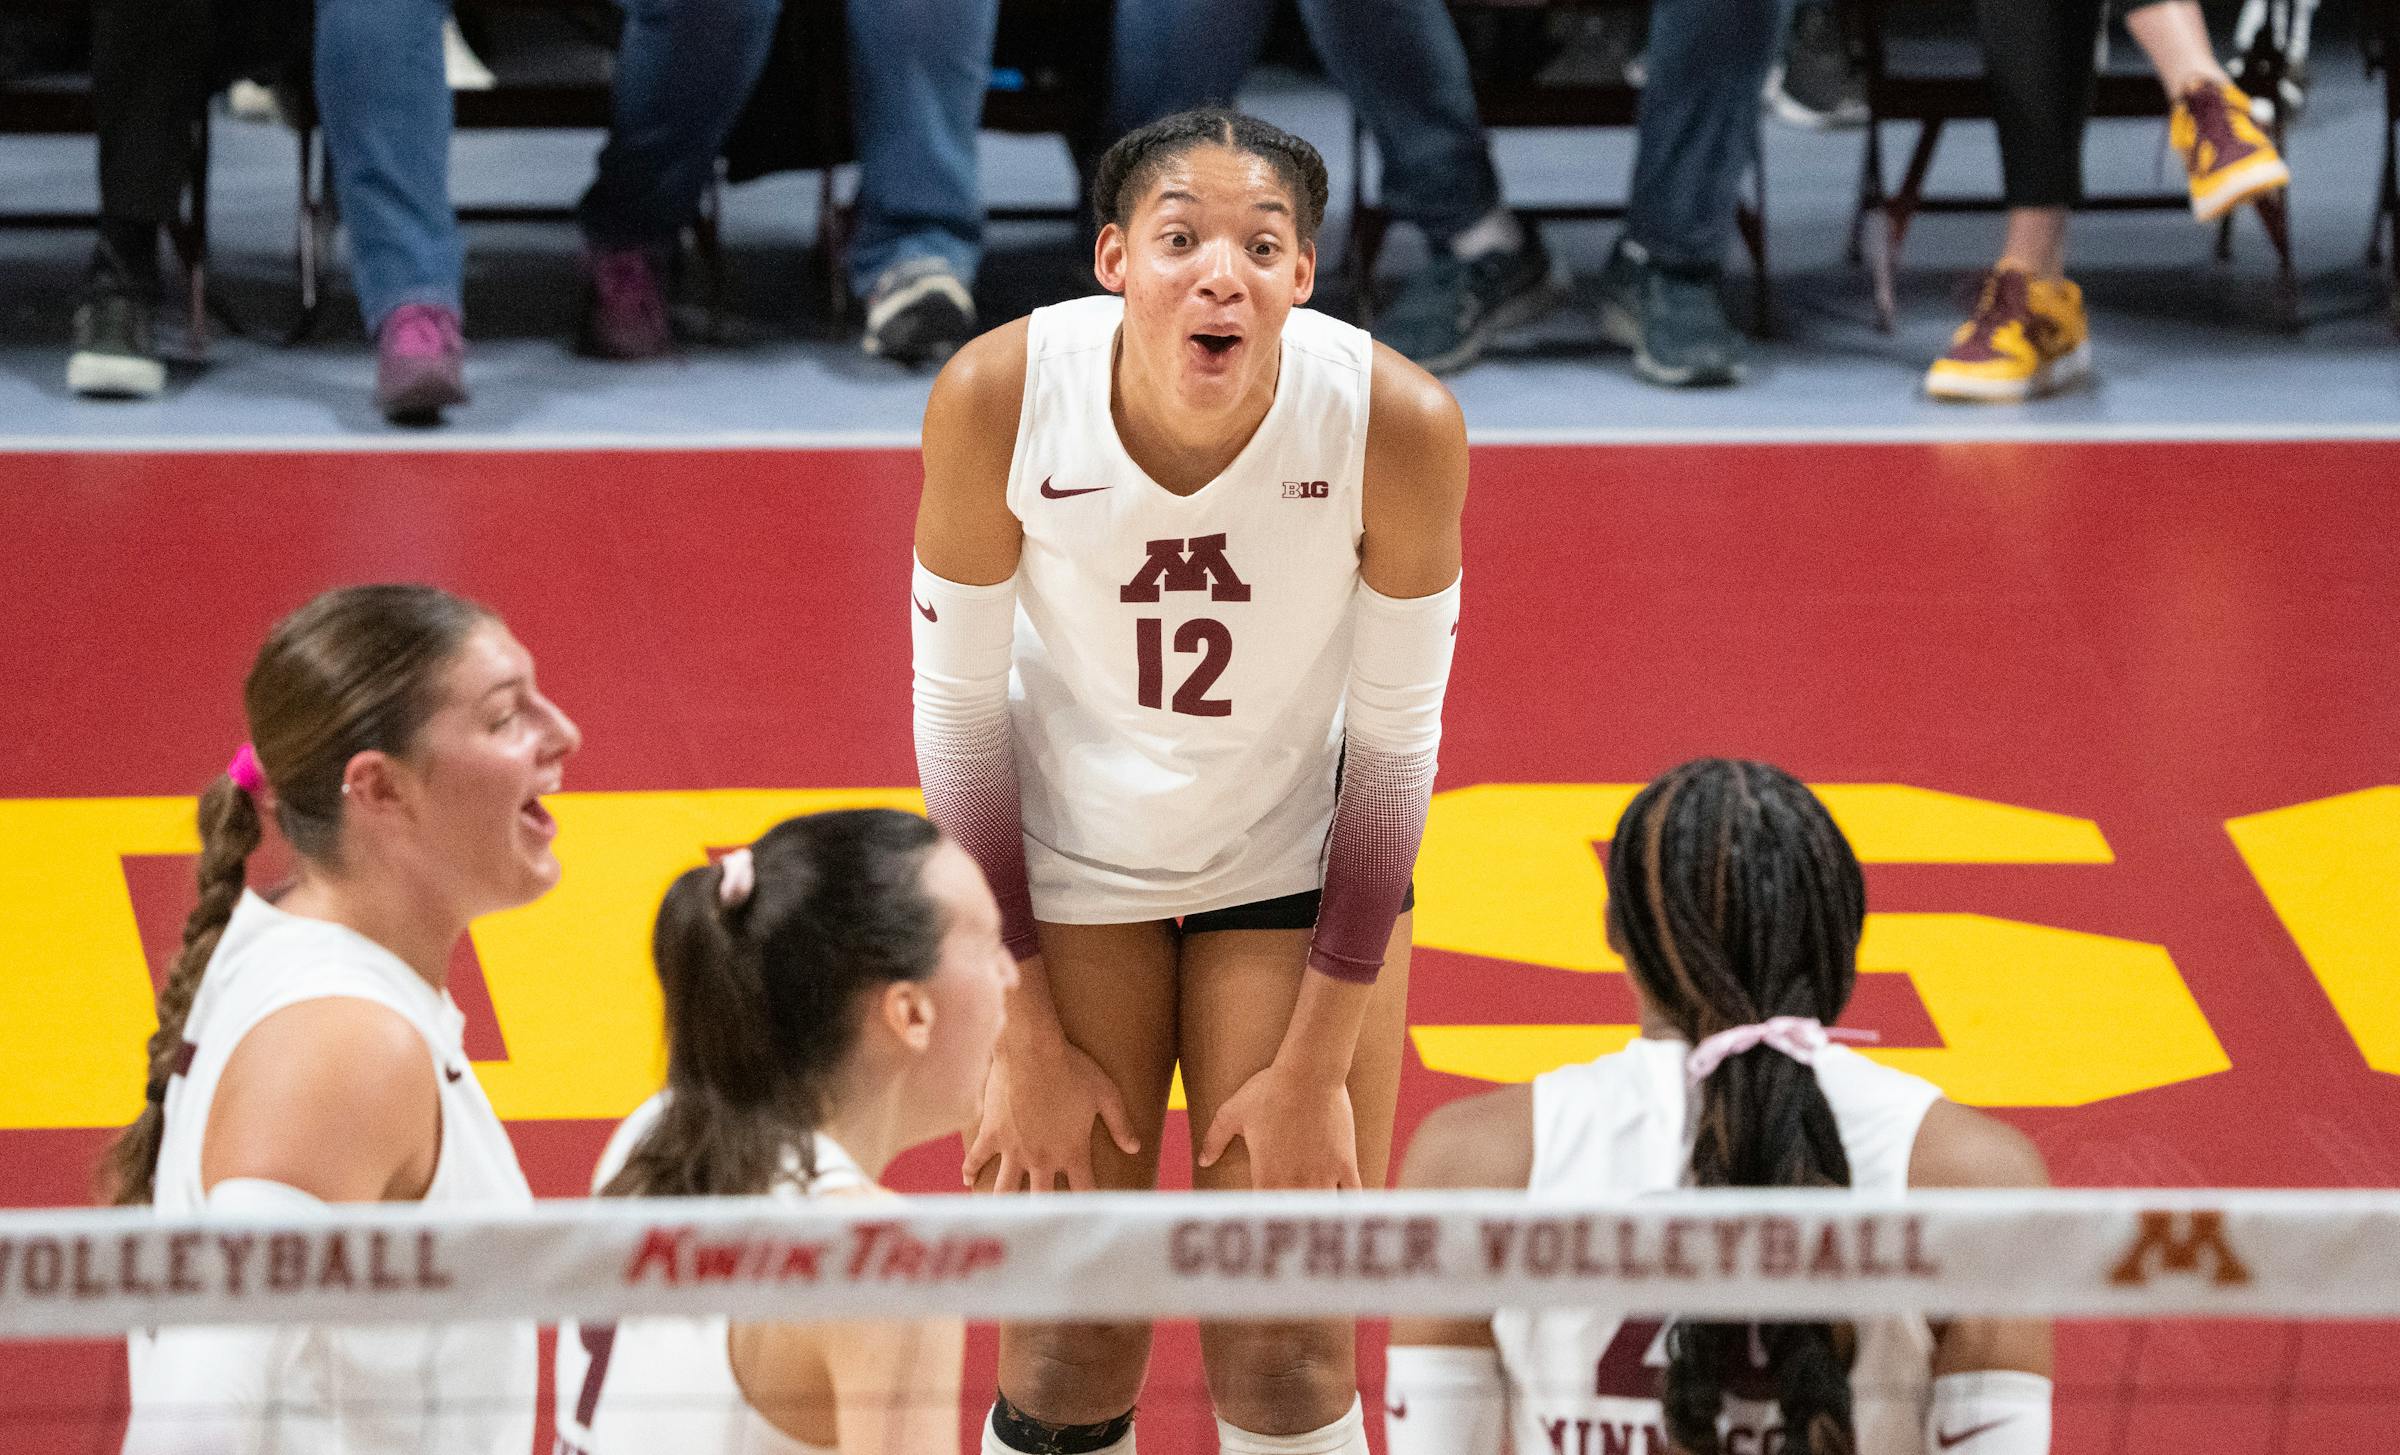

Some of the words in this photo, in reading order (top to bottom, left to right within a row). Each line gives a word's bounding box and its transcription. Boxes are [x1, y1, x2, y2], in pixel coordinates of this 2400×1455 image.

[1120, 532, 1251, 602] M
[1136, 617, 1233, 717] 12
[1170, 1217, 1440, 1280] GOPHER
[1478, 1214, 1942, 1280] VOLLEYBALL
[2108, 1209, 2250, 1285] M
